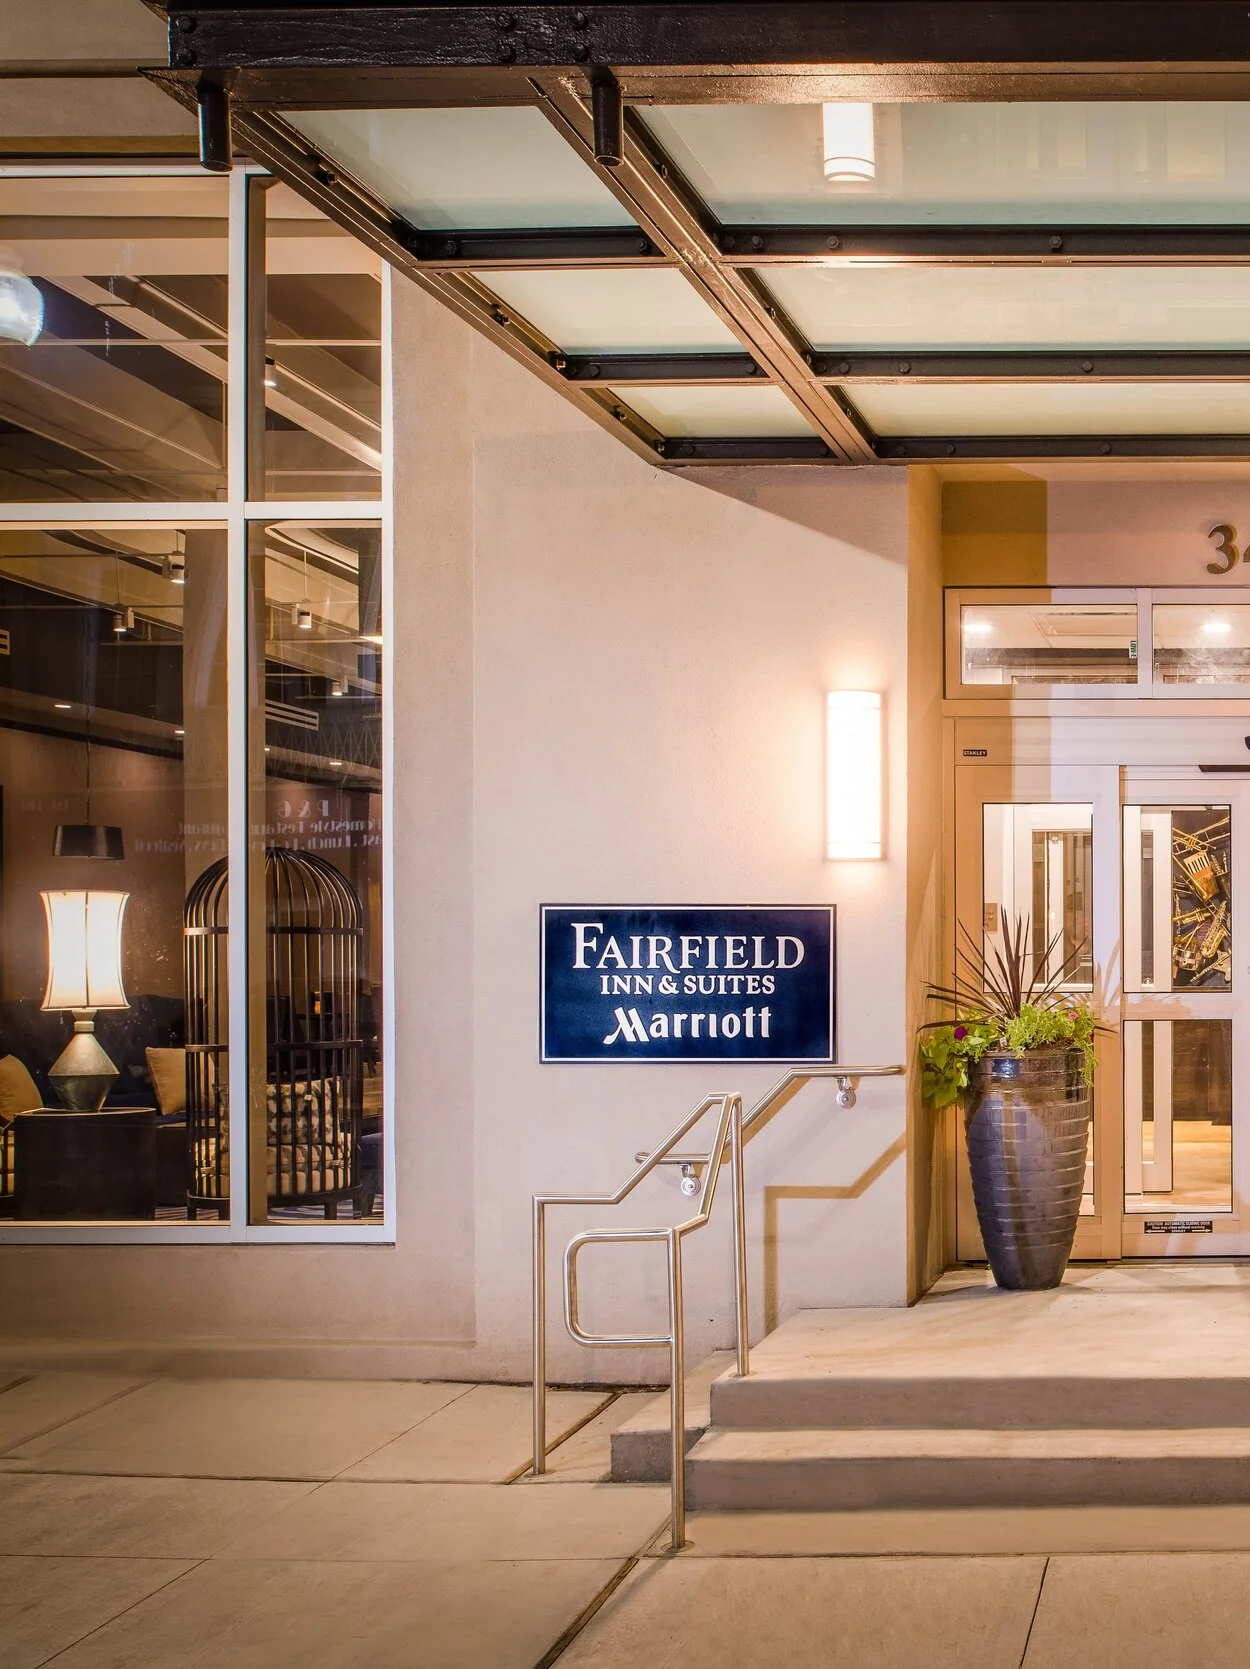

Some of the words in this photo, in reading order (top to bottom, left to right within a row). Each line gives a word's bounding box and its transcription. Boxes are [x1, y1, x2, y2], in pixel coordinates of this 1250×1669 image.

[570, 922, 806, 974] FAIRFIELD
[600, 974, 653, 995] INN
[658, 974, 680, 995] &
[683, 974, 776, 995] SUITES
[602, 1005, 772, 1045] Marriott
